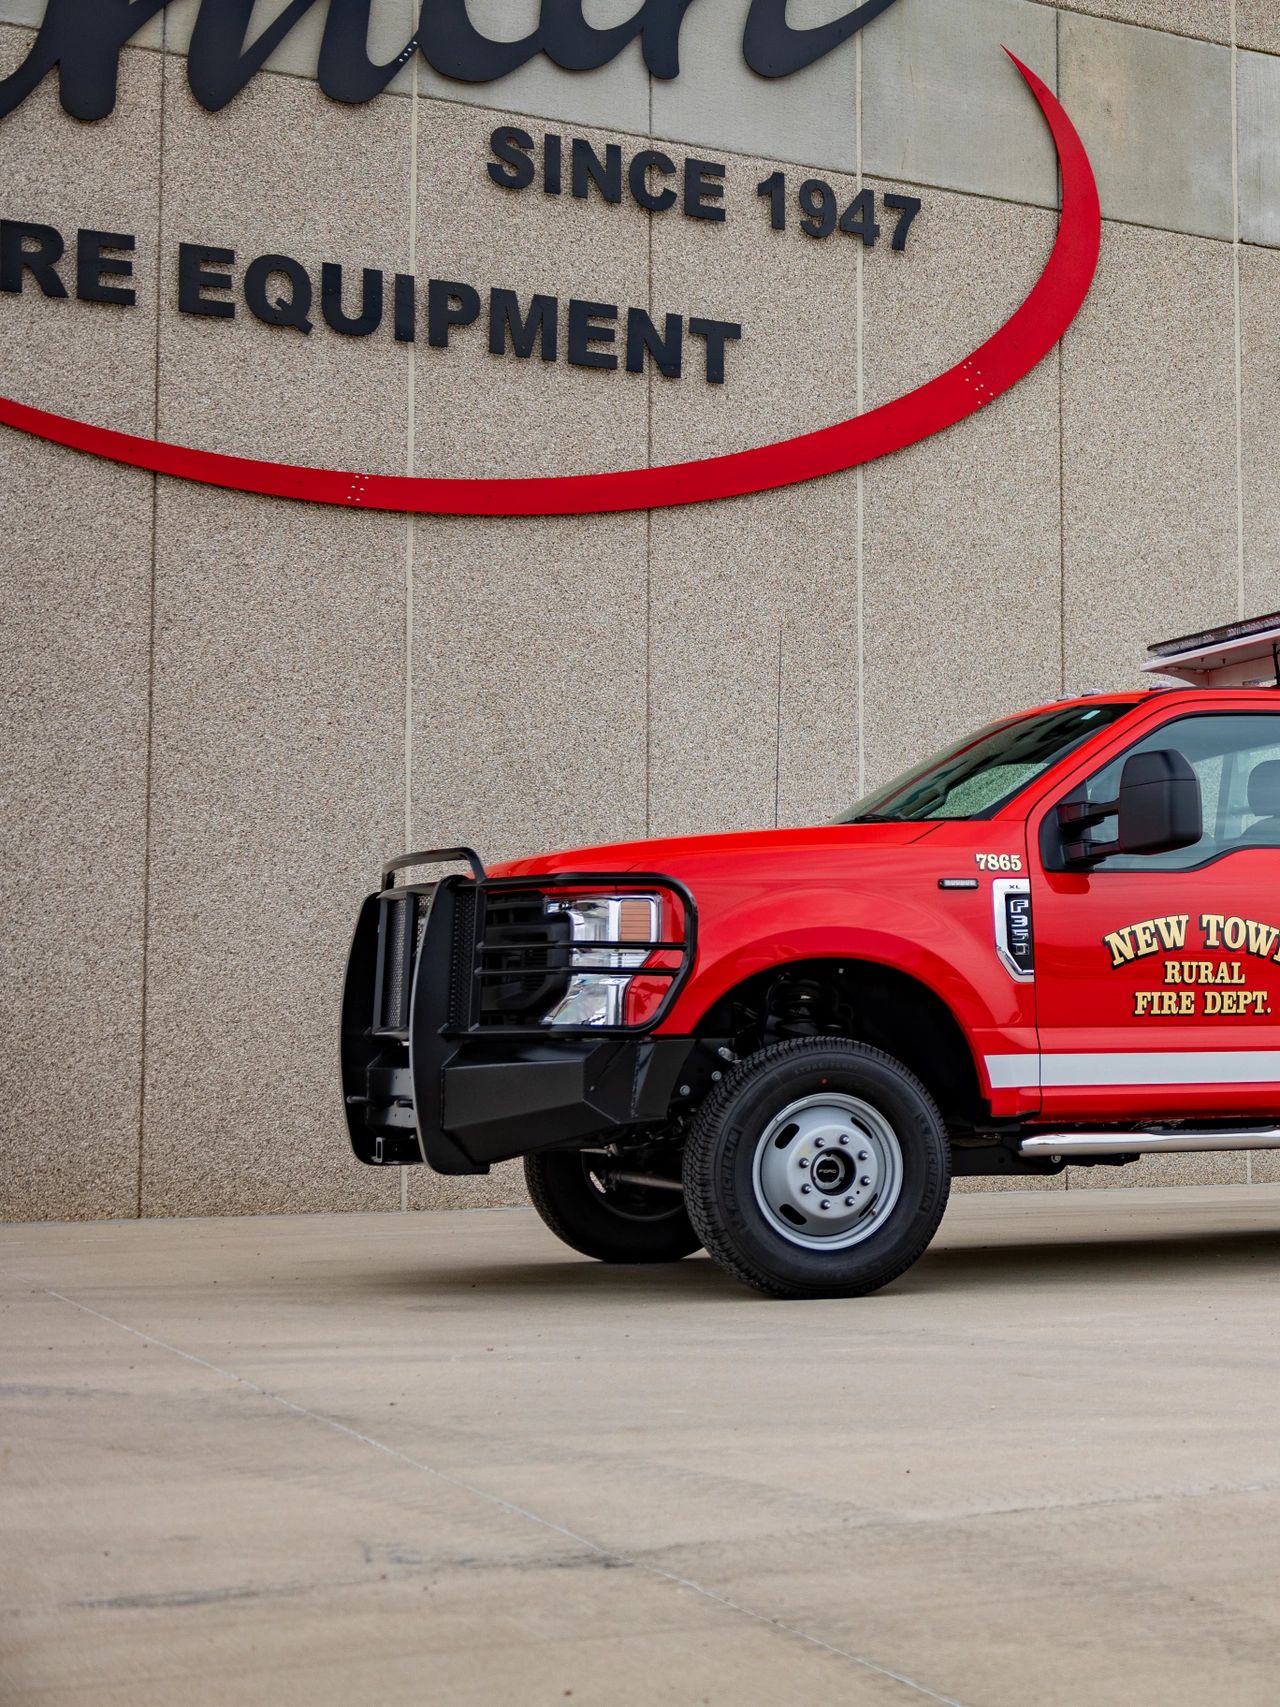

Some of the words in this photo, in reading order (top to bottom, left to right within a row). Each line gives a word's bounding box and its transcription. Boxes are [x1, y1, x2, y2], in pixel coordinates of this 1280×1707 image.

[486, 126, 726, 225] SINCE
[757, 172, 922, 253] 1947
[0, 219, 138, 310] RE
[176, 243, 742, 387] EQUIPMENT
[974, 852, 1023, 872] 7865
[1104, 914, 1189, 967] NEW
[1164, 961, 1246, 984] RURAL
[1134, 991, 1195, 1015] FIRE
[1204, 991, 1272, 1014] DEPT.
[721, 1127, 744, 1210] MICHELIN
[919, 1134, 938, 1213] MICHELIN
